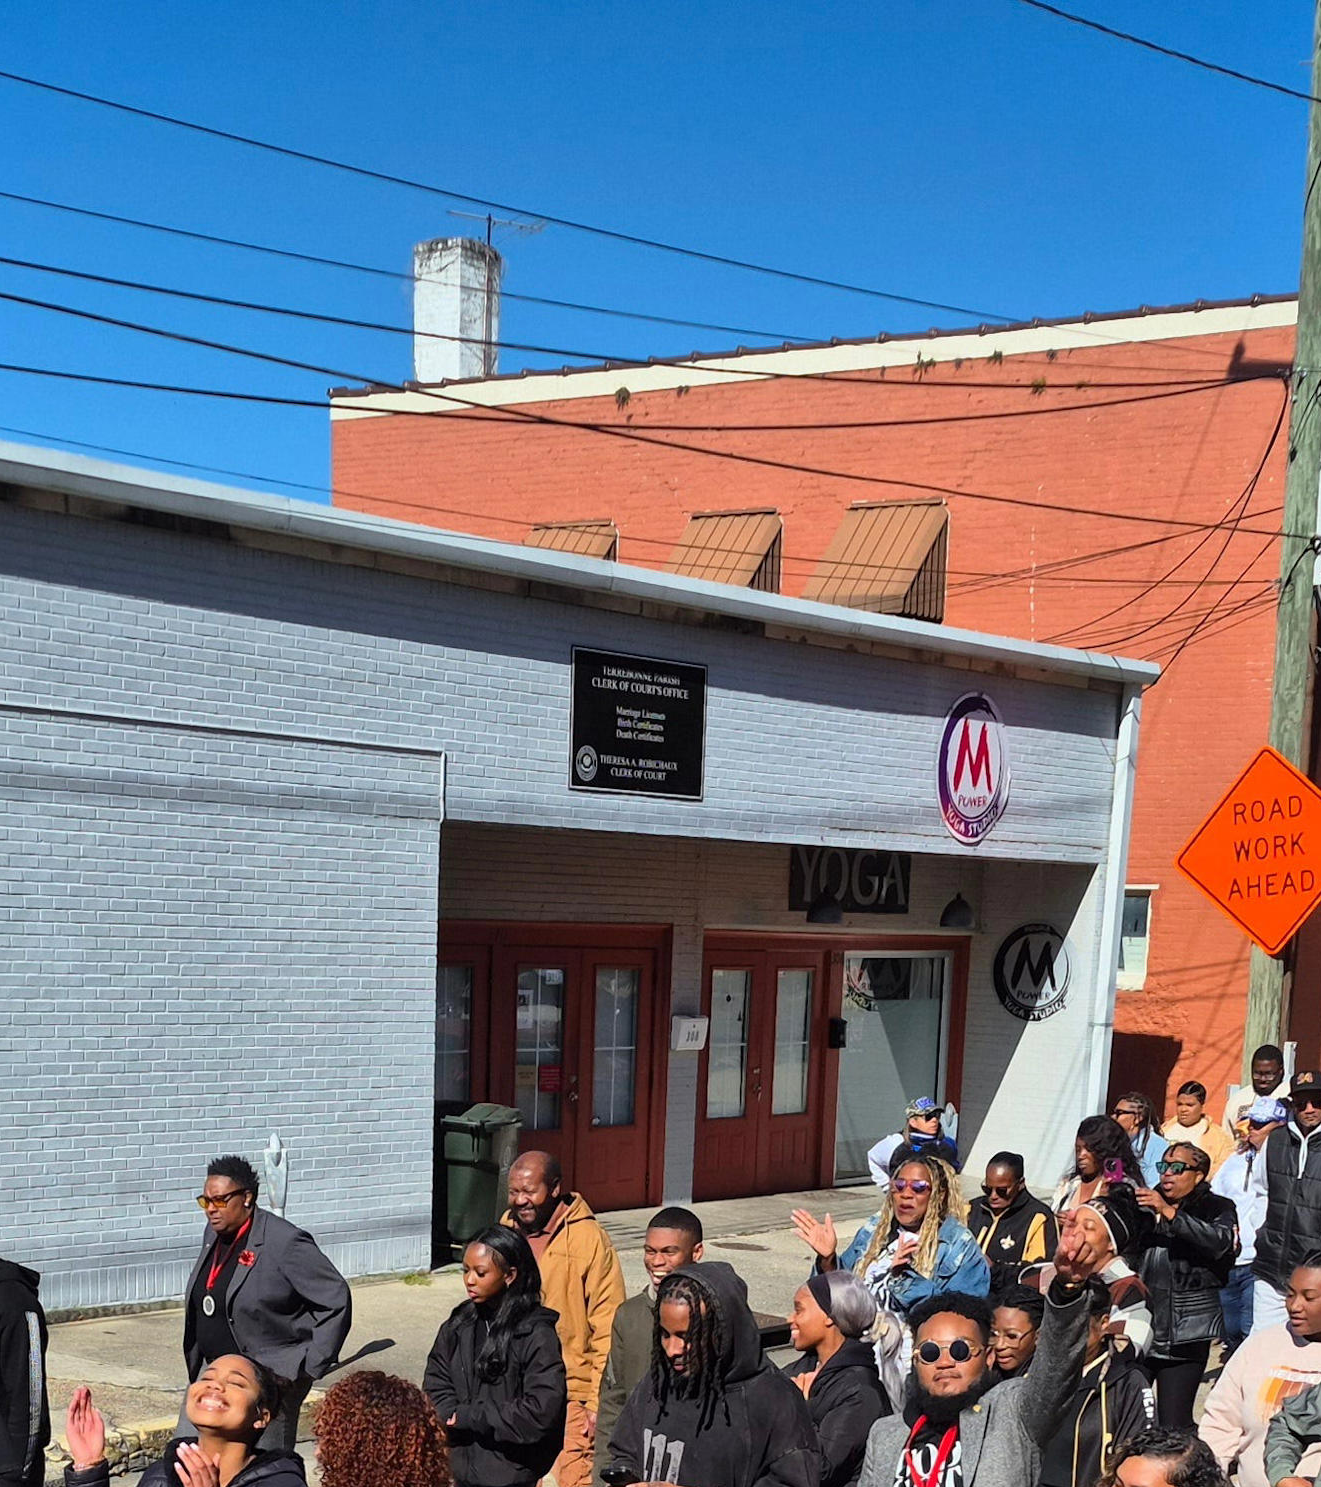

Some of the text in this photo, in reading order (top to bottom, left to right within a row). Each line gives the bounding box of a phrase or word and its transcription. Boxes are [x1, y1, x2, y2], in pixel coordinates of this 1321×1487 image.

[591, 677, 618, 690] CLERK
[619, 681, 629, 692] OF
[663, 687, 690, 700] OFFICE
[953, 717, 993, 795] M
[610, 767, 667, 780] CLERK OF COURT
[958, 794, 988, 808] POWER
[1233, 795, 1303, 825] ROAD
[946, 803, 966, 834] YOGA
[1234, 832, 1306, 863] WORK
[798, 847, 906, 906] YOGA
[1229, 869, 1315, 901] AHEAD
[1011, 937, 1057, 991] M
